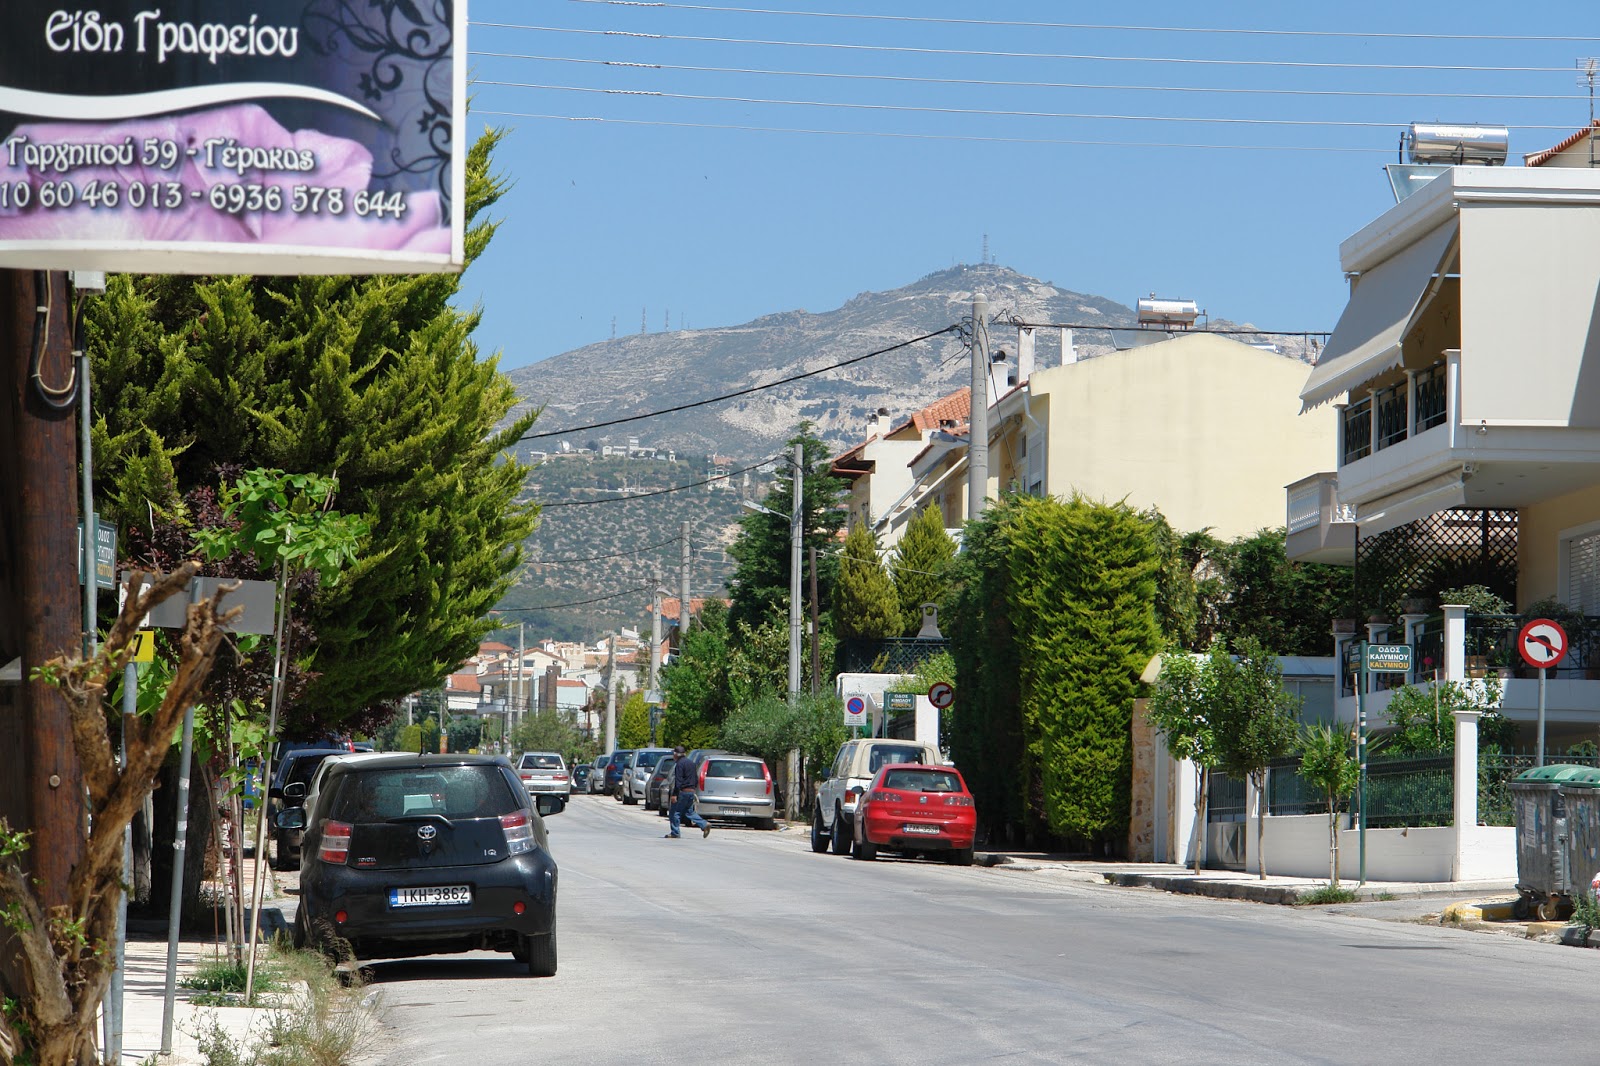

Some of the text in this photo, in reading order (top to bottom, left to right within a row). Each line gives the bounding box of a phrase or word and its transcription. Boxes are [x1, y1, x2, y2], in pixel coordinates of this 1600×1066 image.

[45, 8, 298, 64] Είδη Γραφείου
[142, 138, 178, 170] 59
[39, 181, 74, 208] 60
[81, 179, 119, 208] 46
[127, 181, 183, 209] 013
[209, 183, 282, 214] 6936
[291, 184, 345, 215] 578
[353, 189, 407, 219] 644
